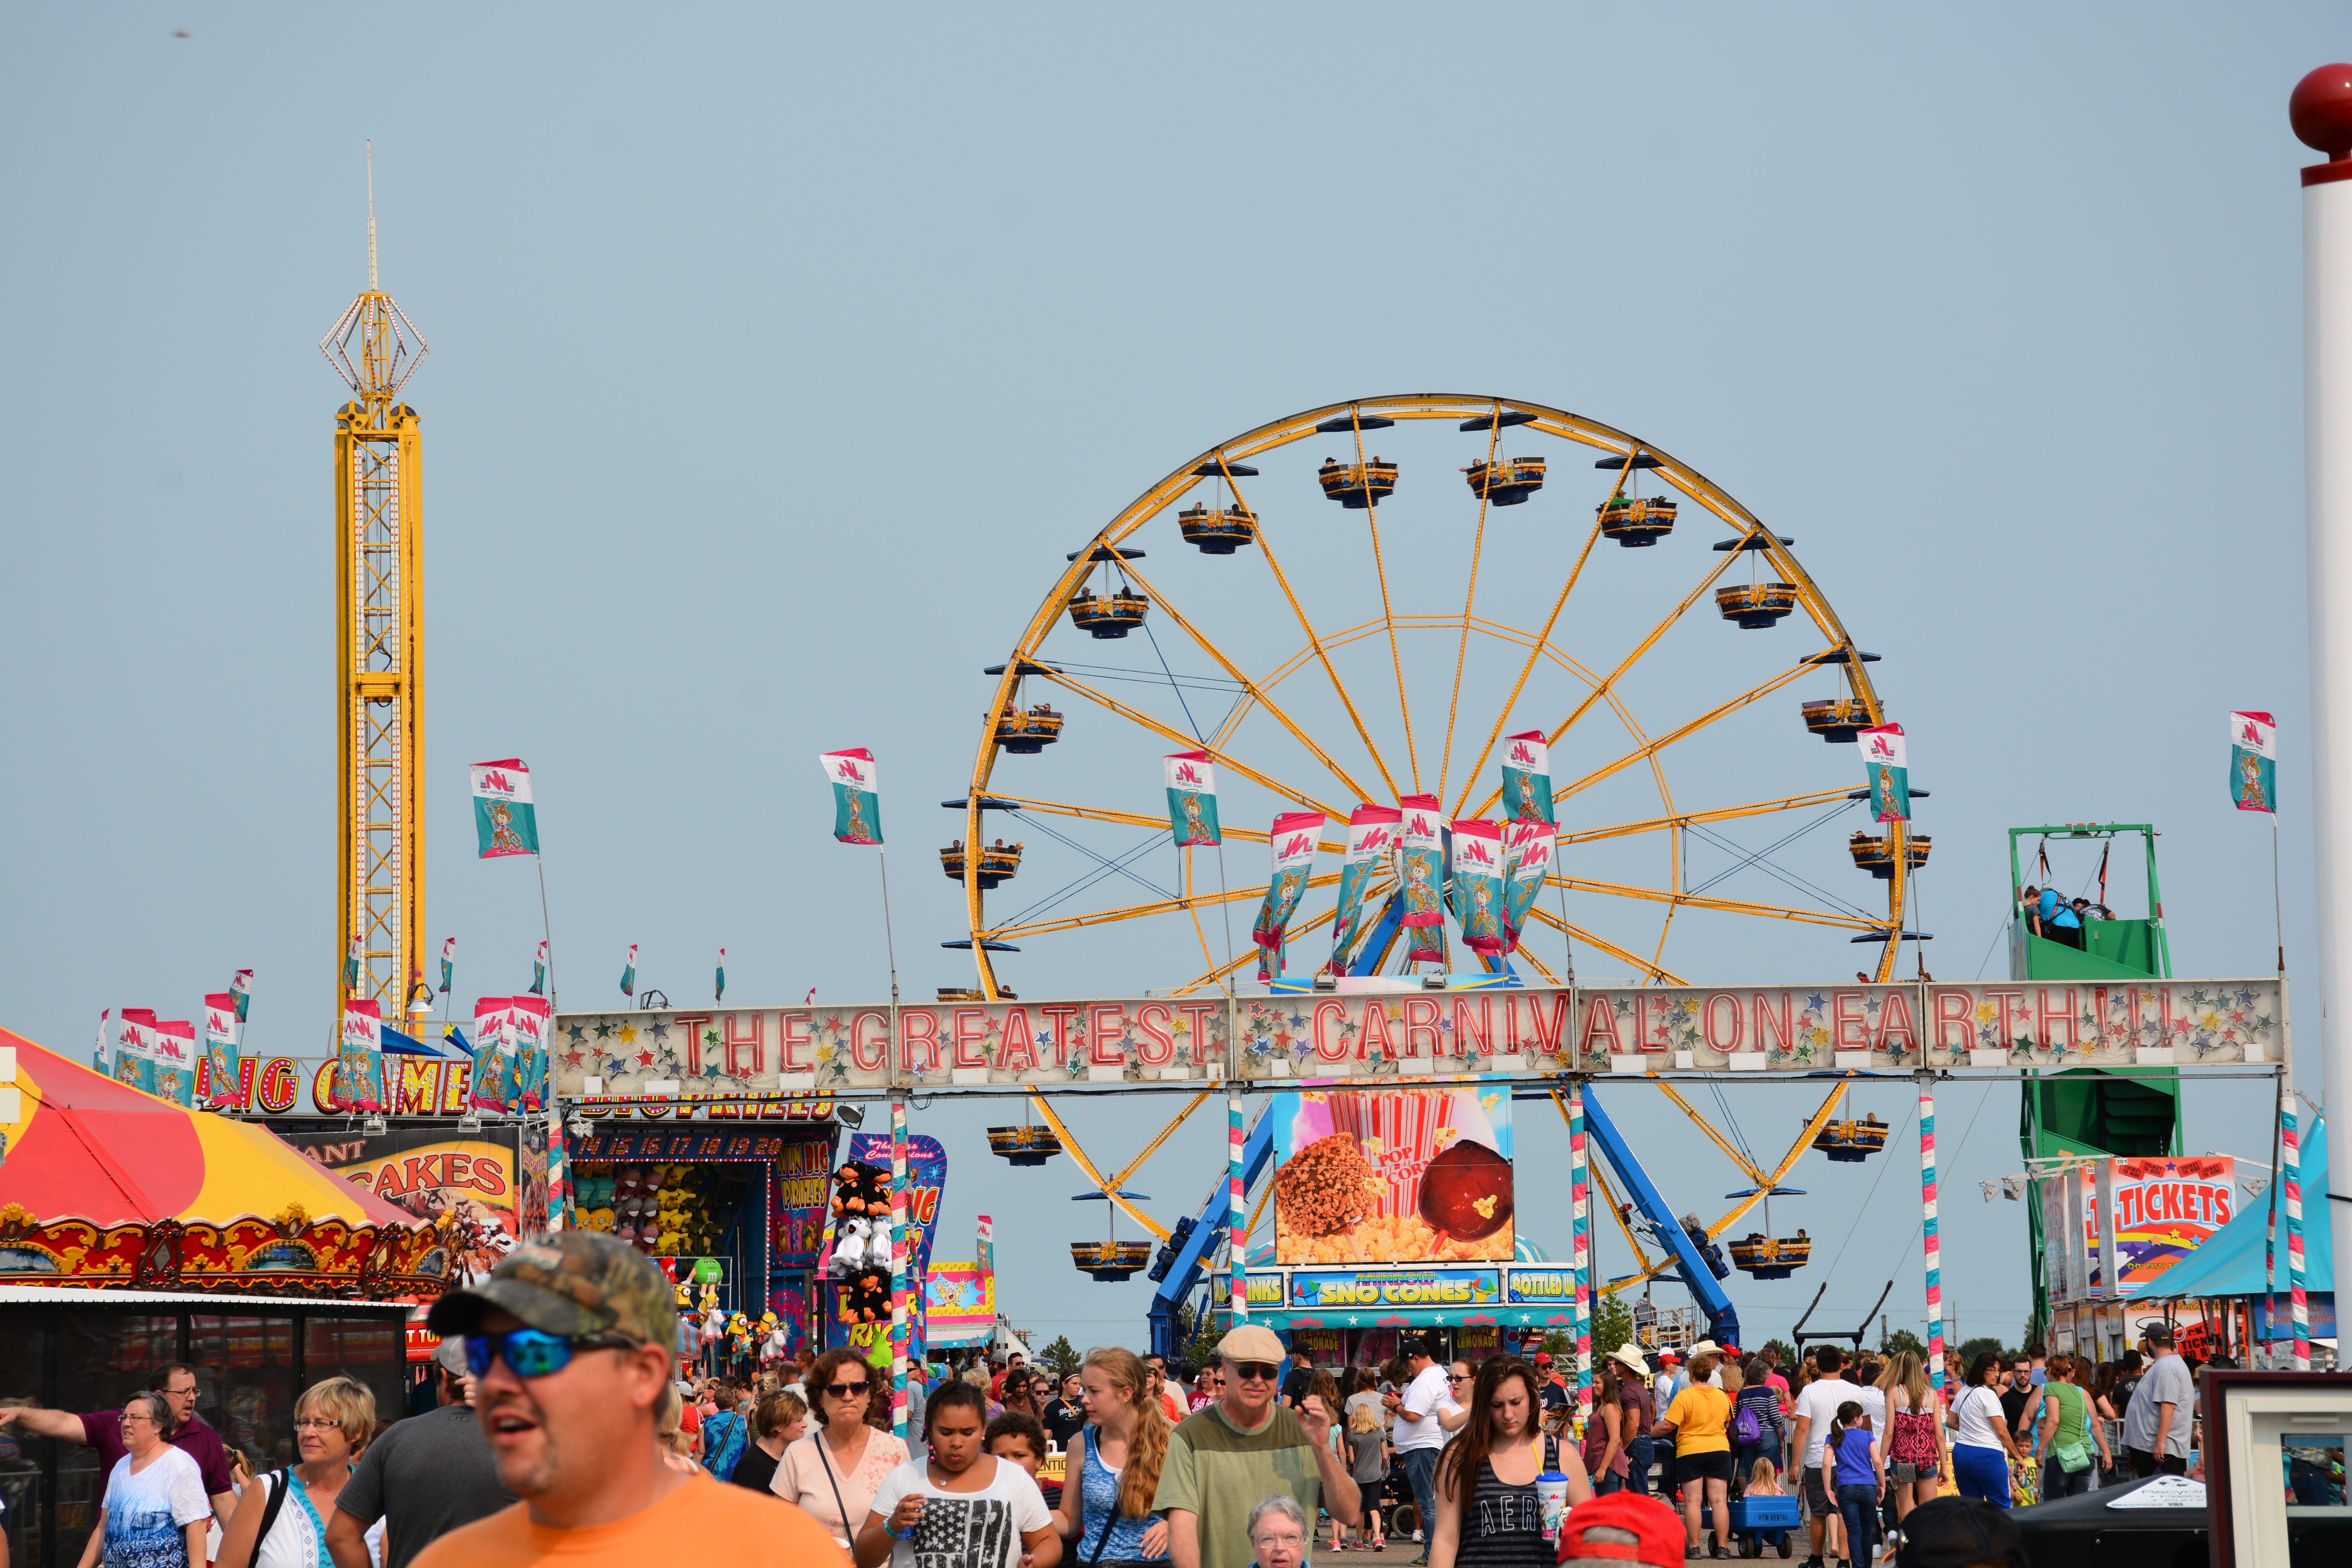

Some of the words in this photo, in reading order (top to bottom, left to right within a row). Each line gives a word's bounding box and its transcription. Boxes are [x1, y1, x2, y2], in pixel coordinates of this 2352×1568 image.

[674, 1009, 815, 1076] THE
[851, 1003, 1217, 1072] GREATEST
[1313, 991, 1669, 1062] CARNIVAL
[1703, 990, 1794, 1054] ON
[297, 1139, 367, 1163] ANT
[578, 1138, 602, 1155] 14
[608, 1138, 633, 1155] 15
[639, 1138, 661, 1155] 16
[670, 1138, 693, 1155] 17
[698, 1138, 721, 1155] 18
[728, 1138, 751, 1155] 19
[754, 1138, 783, 1156] 20
[776, 1143, 802, 1176] WIN
[804, 1141, 829, 1176] BIG
[1377, 1147, 1413, 1167] POP
[2125, 1165, 2142, 1174] TICKET
[2145, 1162, 2163, 1171] TICKET
[2181, 1161, 2199, 1171] TICKET
[781, 1176, 826, 1211] PRIZES
[2118, 1183, 2231, 1226] TICKETS
[1245, 1276, 1282, 1304] INKS
[1356, 1272, 1435, 1287] RAINBOW
[1510, 1273, 1563, 1297] BOTTLED
[1321, 1283, 1381, 1304] SNO
[1383, 1280, 1473, 1304] CONES
[1457, 1334, 1498, 1348] LEMONADE
[2025, 1466, 2038, 1476] UST
[1481, 1495, 1537, 1537] AER
